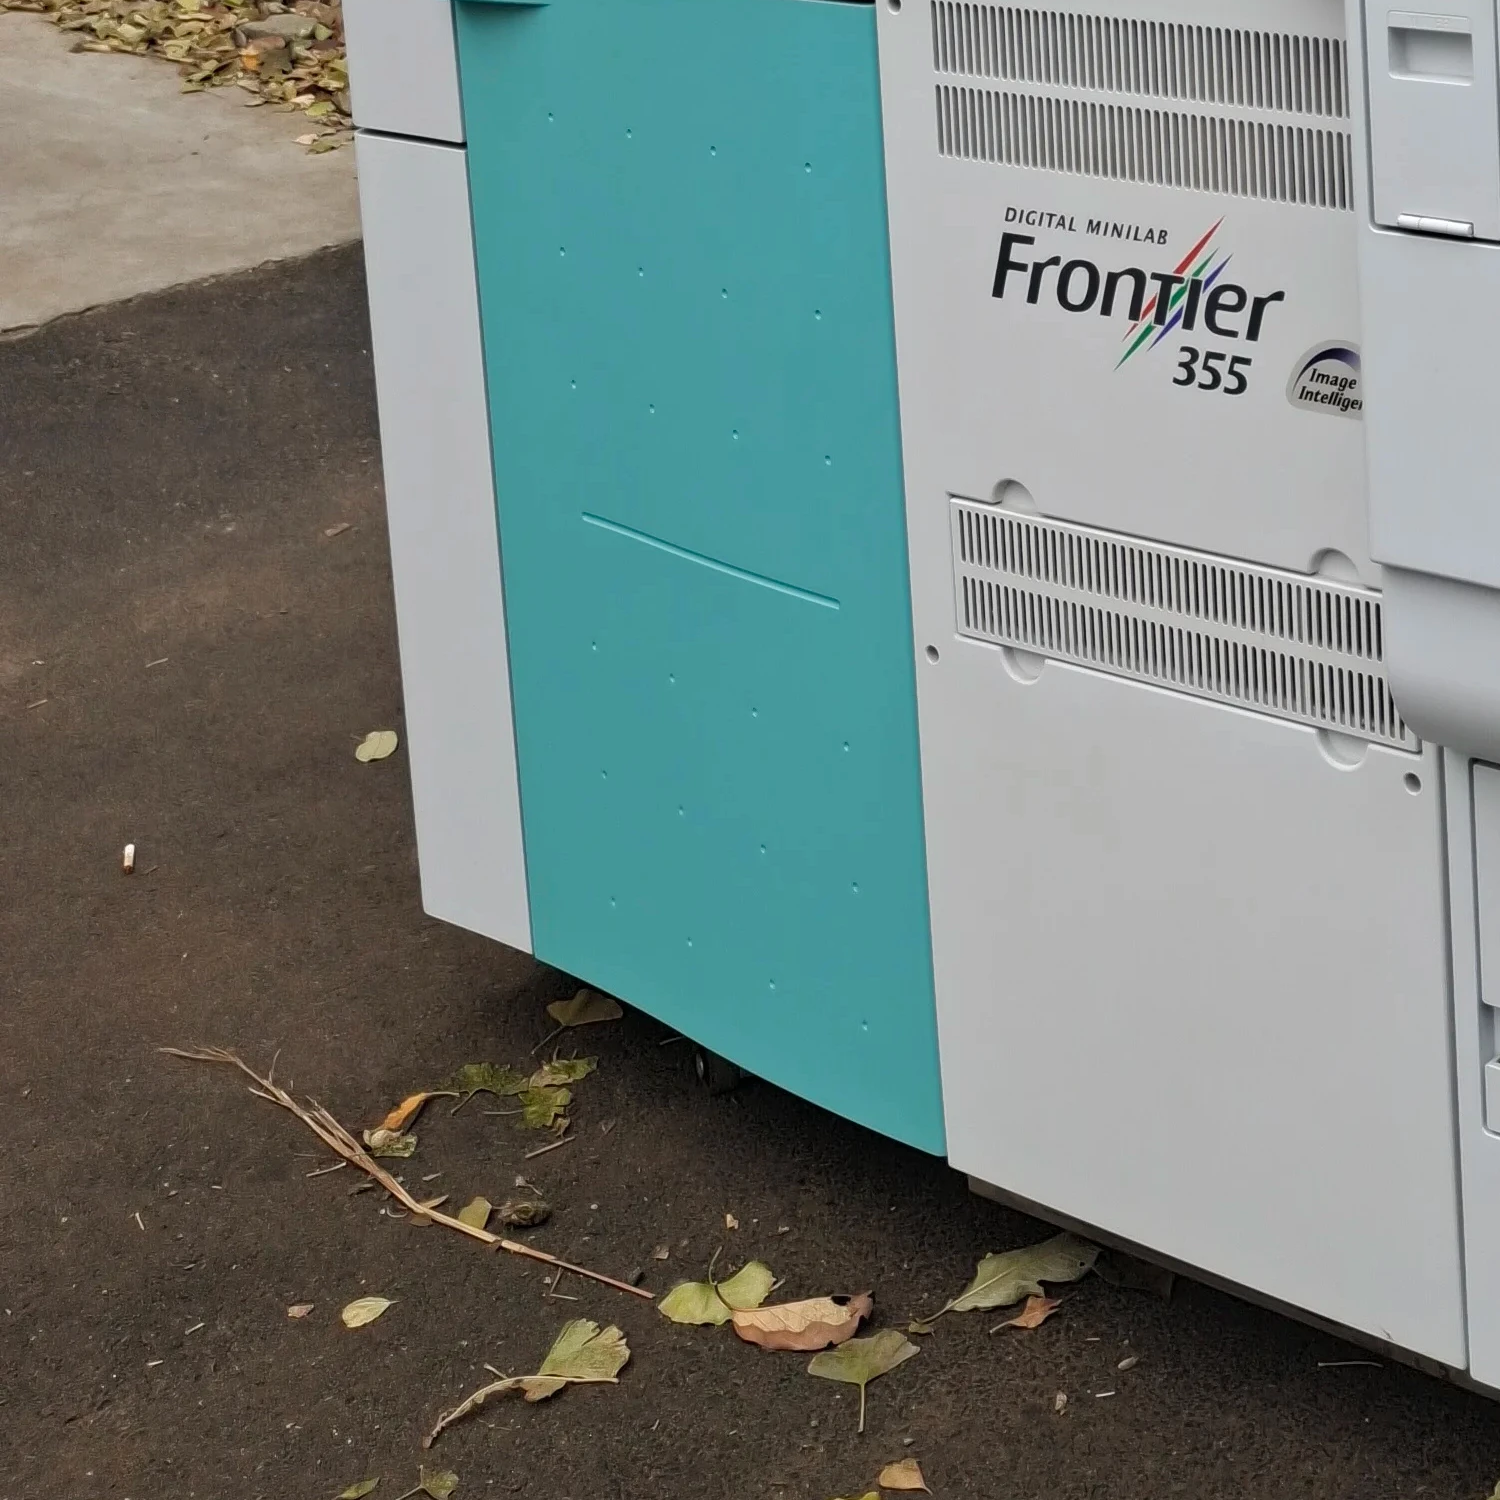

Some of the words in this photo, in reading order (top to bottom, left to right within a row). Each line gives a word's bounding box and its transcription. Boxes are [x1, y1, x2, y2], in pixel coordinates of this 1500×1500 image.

[1004, 206, 1077, 232] DIGITAL
[1086, 218, 1169, 246] MINILAB
[1172, 345, 1252, 396] 355
[1309, 368, 1357, 391] Image
